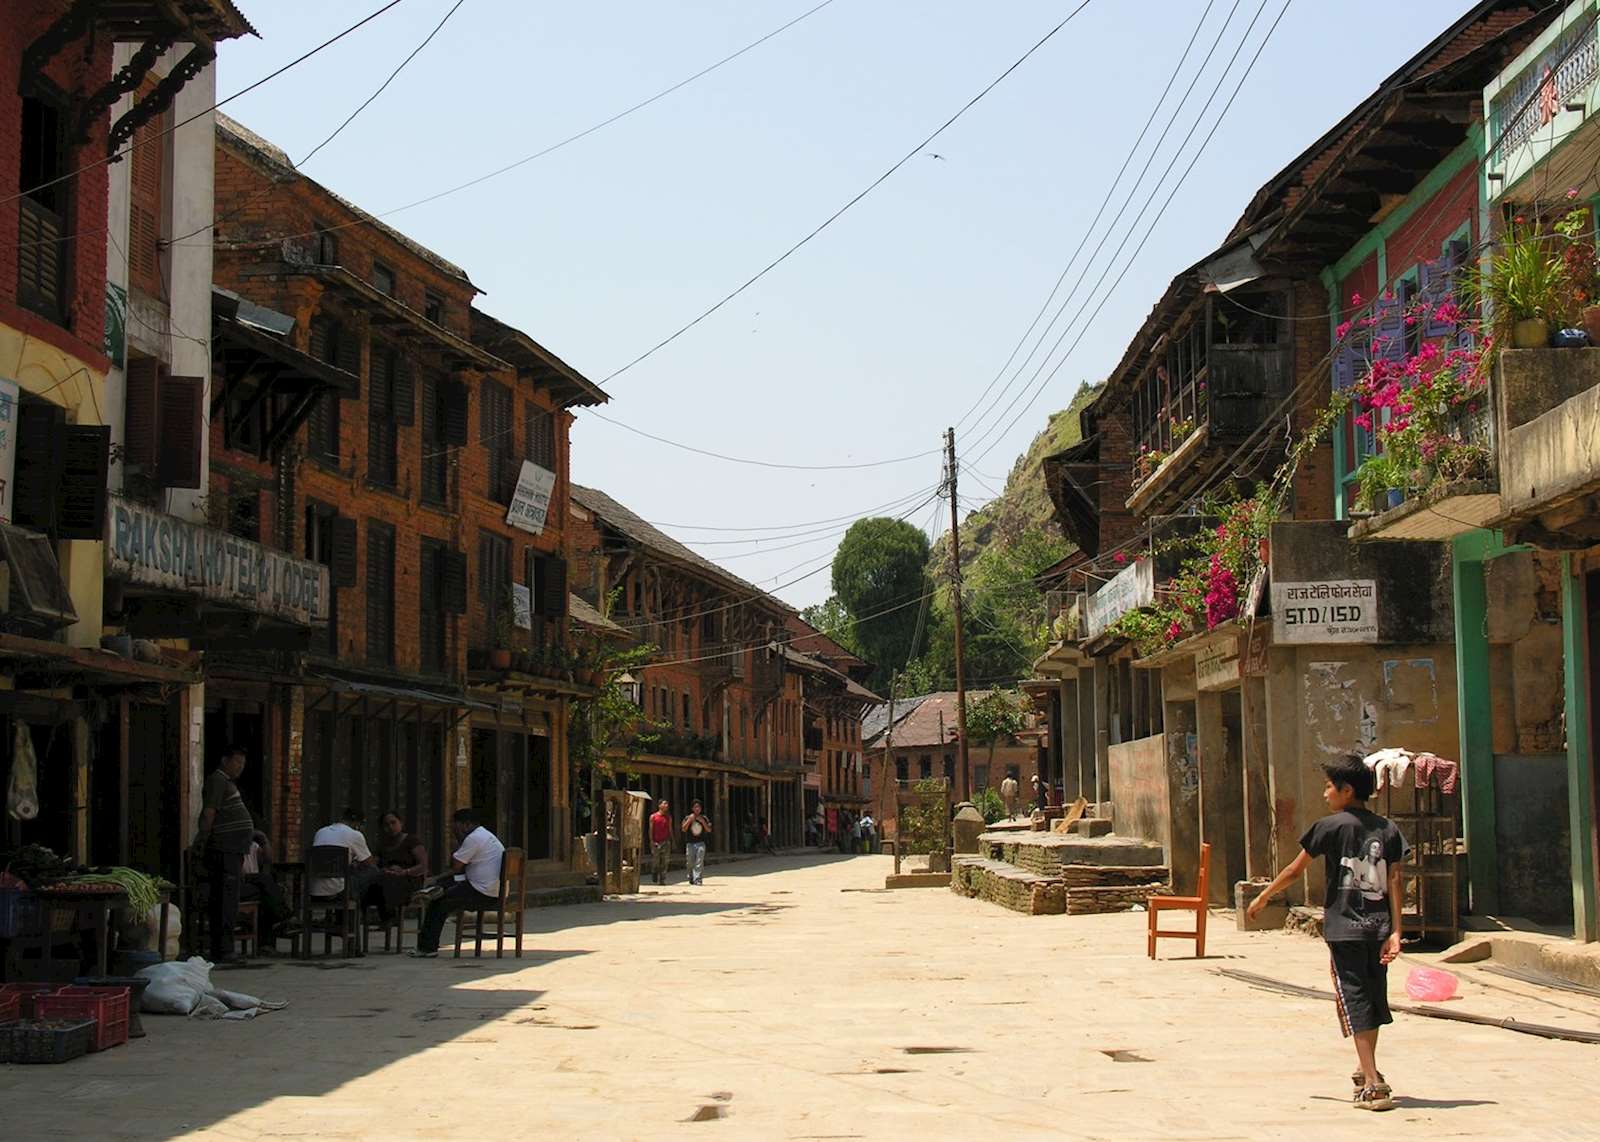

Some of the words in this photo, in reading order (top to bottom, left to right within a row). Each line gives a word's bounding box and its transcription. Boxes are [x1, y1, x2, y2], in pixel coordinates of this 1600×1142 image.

[114, 506, 200, 583] RAKSHA
[203, 532, 258, 598] HOTEL
[272, 556, 321, 620] LODGE
